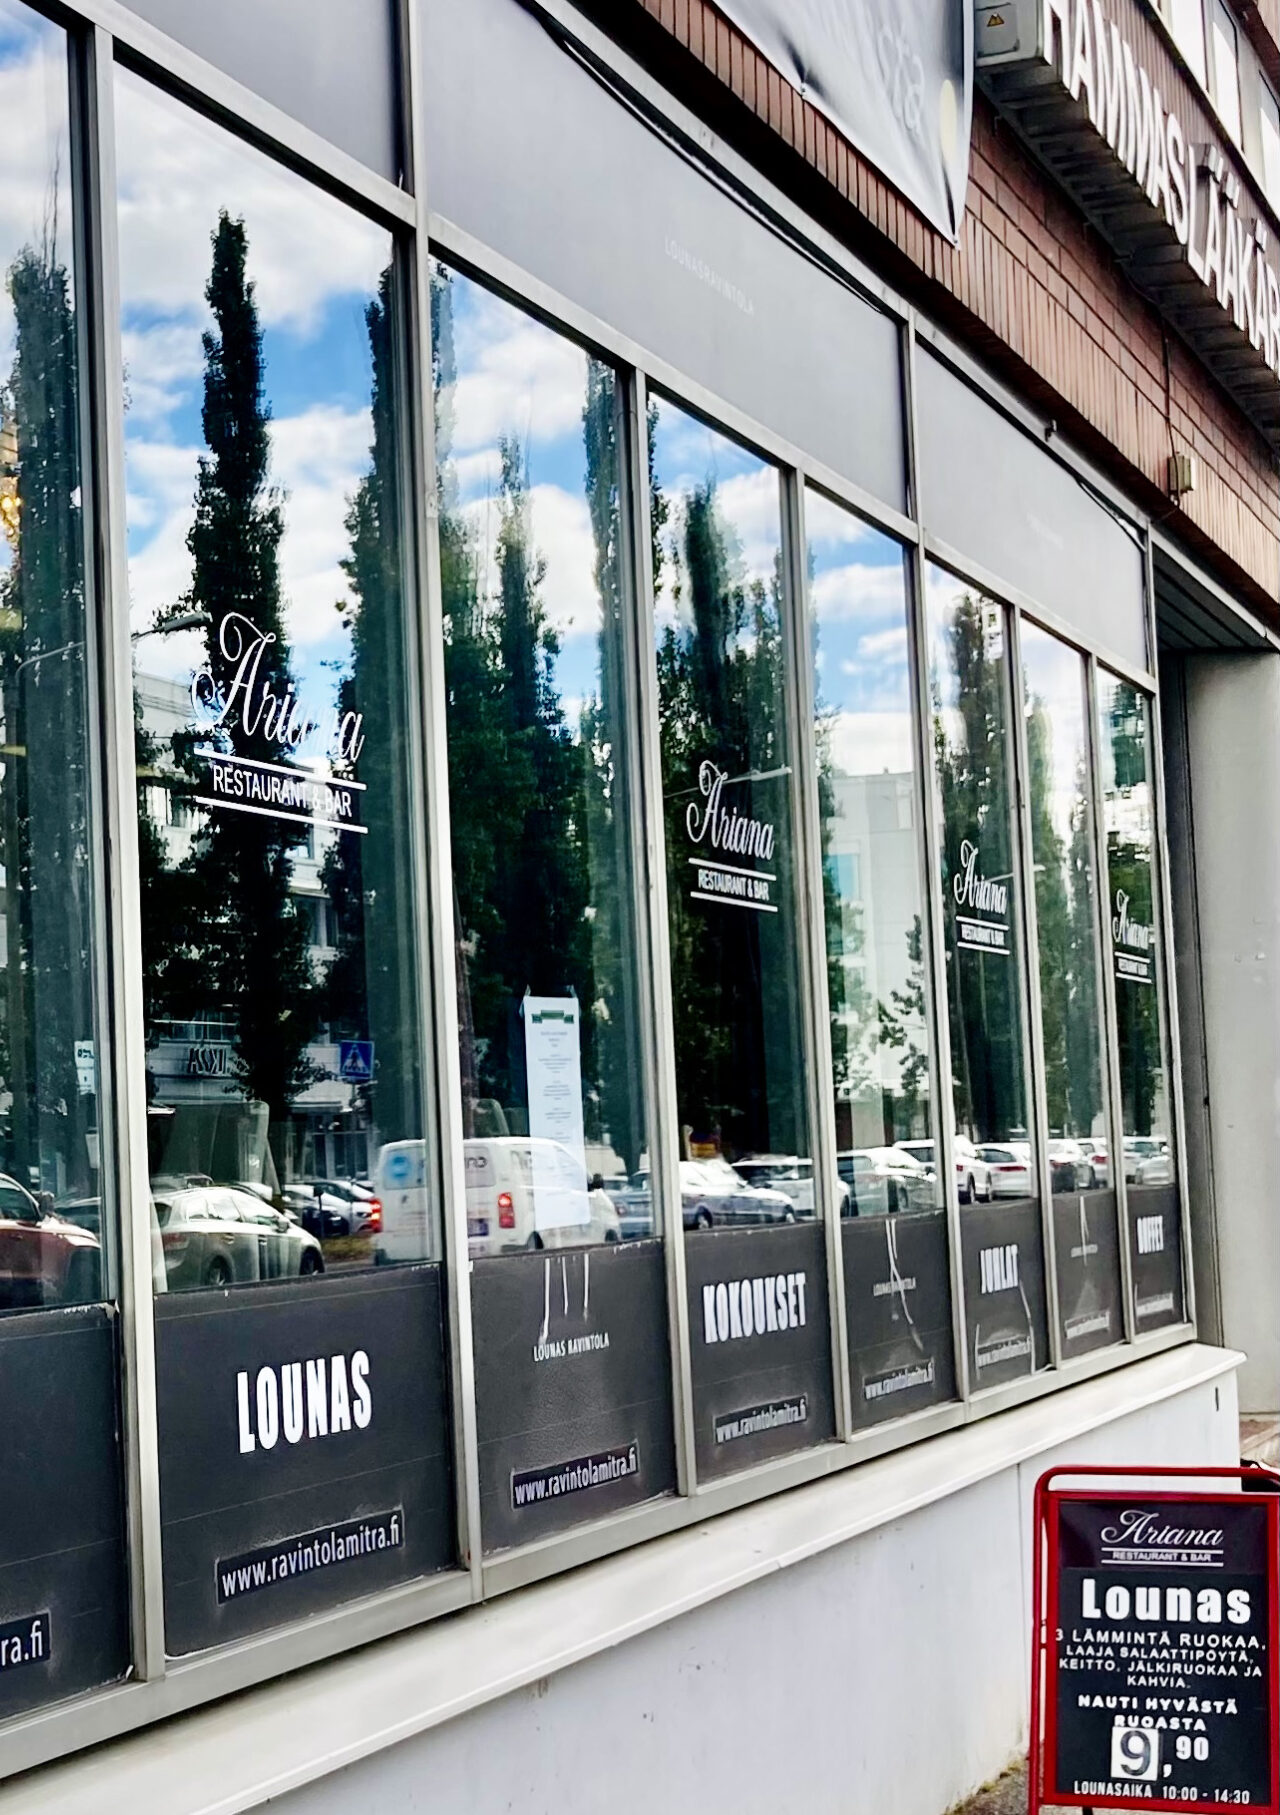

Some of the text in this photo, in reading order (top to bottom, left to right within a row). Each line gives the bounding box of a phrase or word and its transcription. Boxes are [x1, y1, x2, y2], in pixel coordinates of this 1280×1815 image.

[213, 765, 307, 808] RESTAURANT
[325, 786, 352, 817] BAR
[686, 760, 774, 860] Ariana
[754, 880, 769, 901] BAR
[954, 840, 1007, 915] Ariana
[703, 1272, 806, 1344] KOKOUKSET
[534, 1332, 610, 1361] LOUNAS RAVINTOLA
[237, 1350, 372, 1453] LOUNAS
[515, 1447, 637, 1505] www.ravintolamitra.fi
[1101, 1509, 1223, 1546] Ariana
[222, 1515, 399, 1597] www.ravintolamitra.fi
[1113, 1550, 1211, 1562] RESTAURANT & BAR
[1082, 1578, 1251, 1624] Lounas
[1055, 1628, 1063, 1641] 3
[1072, 1628, 1170, 1646] LÄMMINTÄ
[1066, 1645, 1114, 1657] LAAJA
[1127, 1660, 1238, 1677] JÄLKIRUOKAA
[1243, 1665, 1262, 1677] JA
[1078, 1694, 1238, 1714] NAUTI HYVÄSTÄ
[1114, 1714, 1206, 1731] RUOASTA
[1074, 1780, 1153, 1798] LOUNASAIKA
[1163, 1785, 1198, 1801] 10:00
[1214, 1789, 1250, 1805] 14:30
